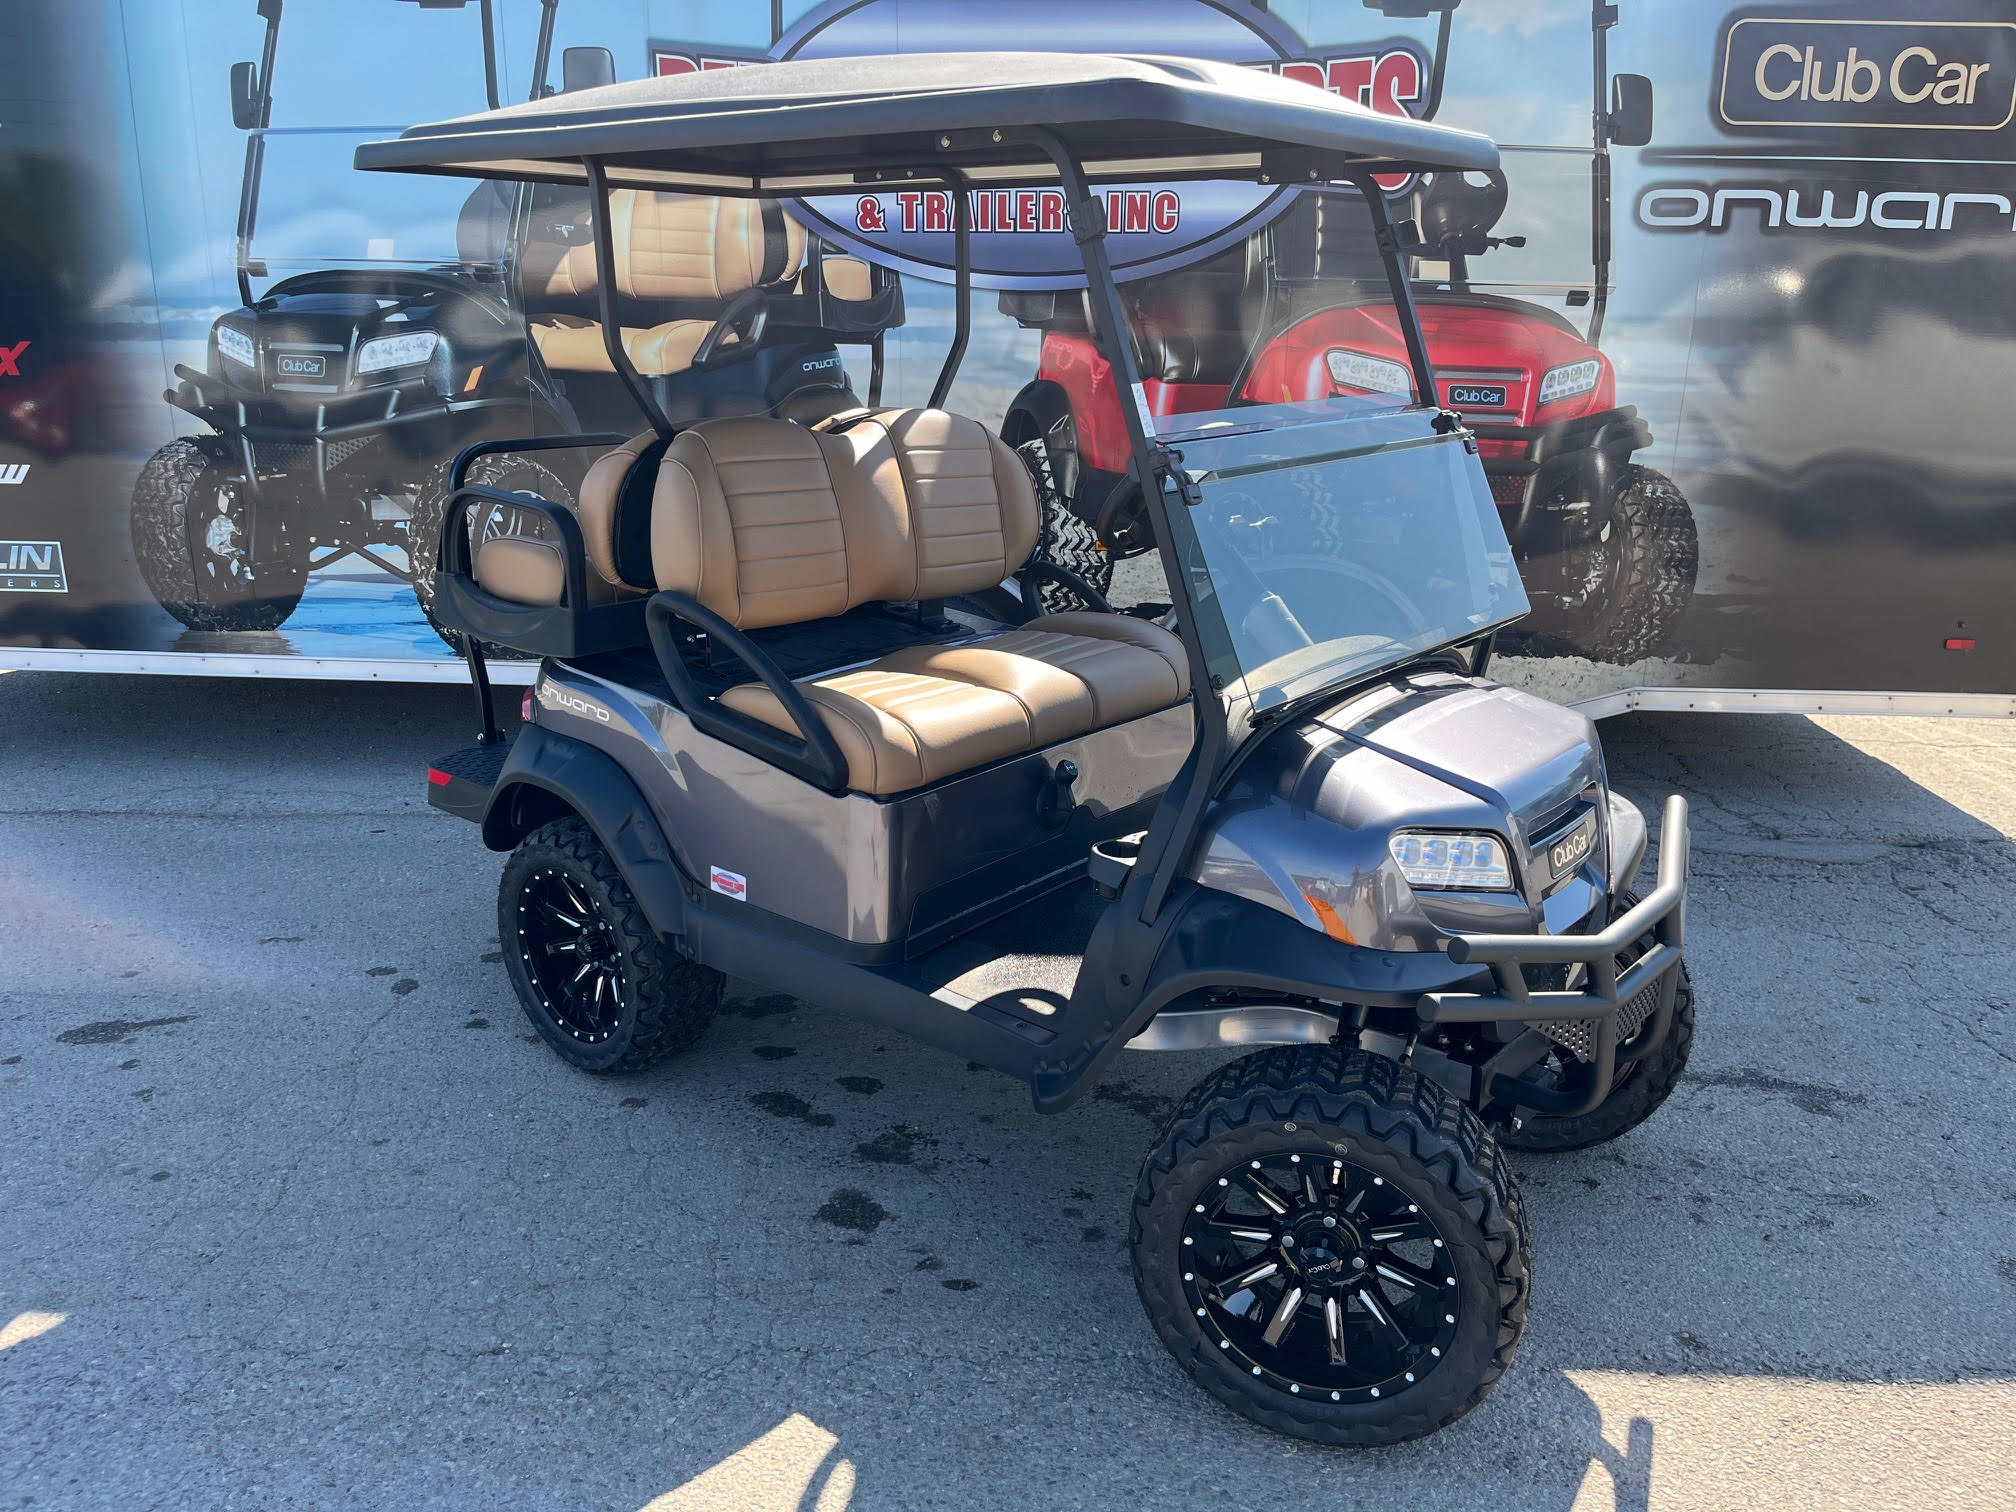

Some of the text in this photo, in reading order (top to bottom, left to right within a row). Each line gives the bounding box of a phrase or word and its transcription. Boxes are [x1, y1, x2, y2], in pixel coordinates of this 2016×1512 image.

[1754, 43, 1990, 106] Club Car
[856, 195, 887, 232] &
[1105, 190, 1180, 233] INC
[1638, 188, 2016, 232] onwar
[282, 359, 321, 373] Club Car
[1454, 389, 1501, 403] Club Car
[1554, 834, 1587, 867] Club Car
